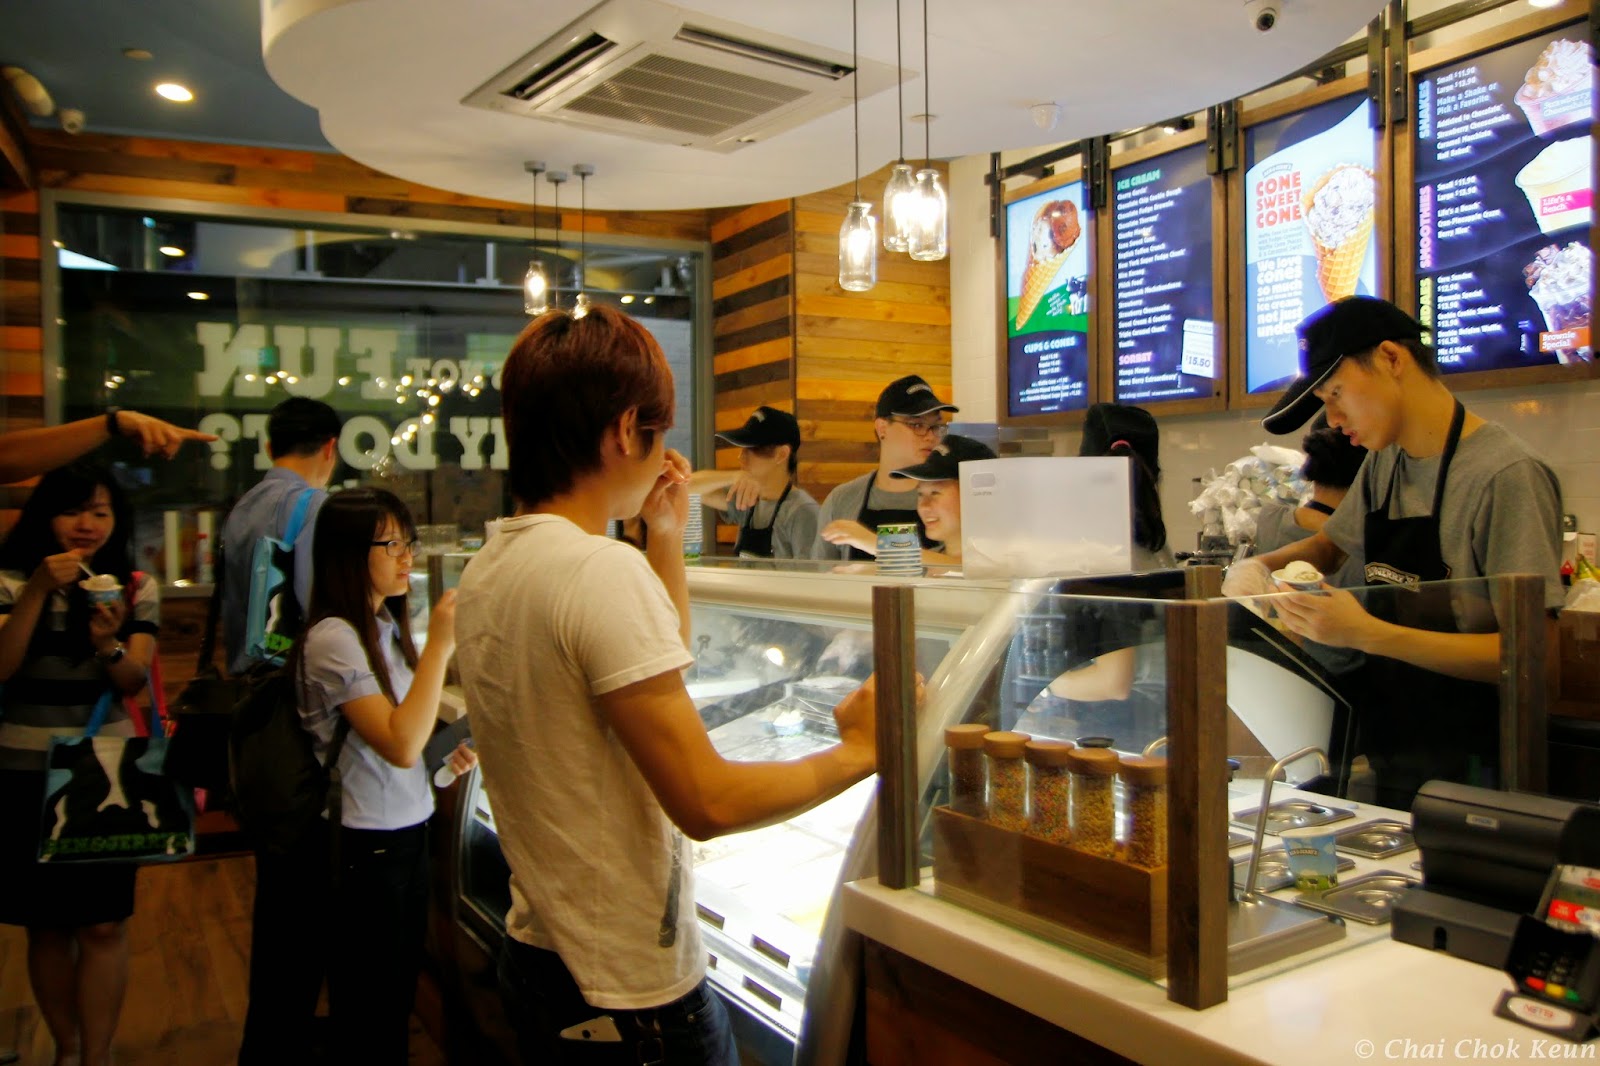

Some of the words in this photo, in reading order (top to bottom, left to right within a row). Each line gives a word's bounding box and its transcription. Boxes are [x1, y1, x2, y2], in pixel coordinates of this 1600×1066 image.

[1437, 74, 1453, 85] Small
[1454, 67, 1476, 79] $11.90
[1437, 84, 1454, 95] Large
[1437, 95, 1456, 106] Make
[1464, 86, 1487, 99] Shake
[1488, 83, 1496, 91] or
[1418, 80, 1430, 138] SHAKES
[1437, 104, 1452, 115] Pick
[1460, 95, 1490, 110] Favorite
[1437, 115, 1462, 128] Addicted
[1471, 104, 1502, 120] Chocolate
[1437, 125, 1468, 140] Strawberry
[1437, 138, 1462, 150] Caramel
[1117, 178, 1130, 191] ICE
[1131, 169, 1160, 186] CREAM
[1256, 171, 1301, 196] CONE
[1437, 180, 1454, 192] Small
[1256, 188, 1302, 212] SWEET
[1437, 190, 1454, 202] Large
[1256, 204, 1302, 228] CONE
[1420, 185, 1432, 269] SMOOTHIES
[1257, 260, 1275, 272] We
[1276, 256, 1302, 268] love
[1257, 266, 1302, 285] cones
[1257, 286, 1270, 296] so
[1272, 279, 1302, 294] much
[1257, 311, 1278, 324] not
[1024, 342, 1044, 354] CUPS
[1050, 336, 1076, 350] CONES
[1543, 332, 1576, 342] Brownie
[1543, 339, 1571, 350] Special
[1118, 351, 1152, 365] SORBET
